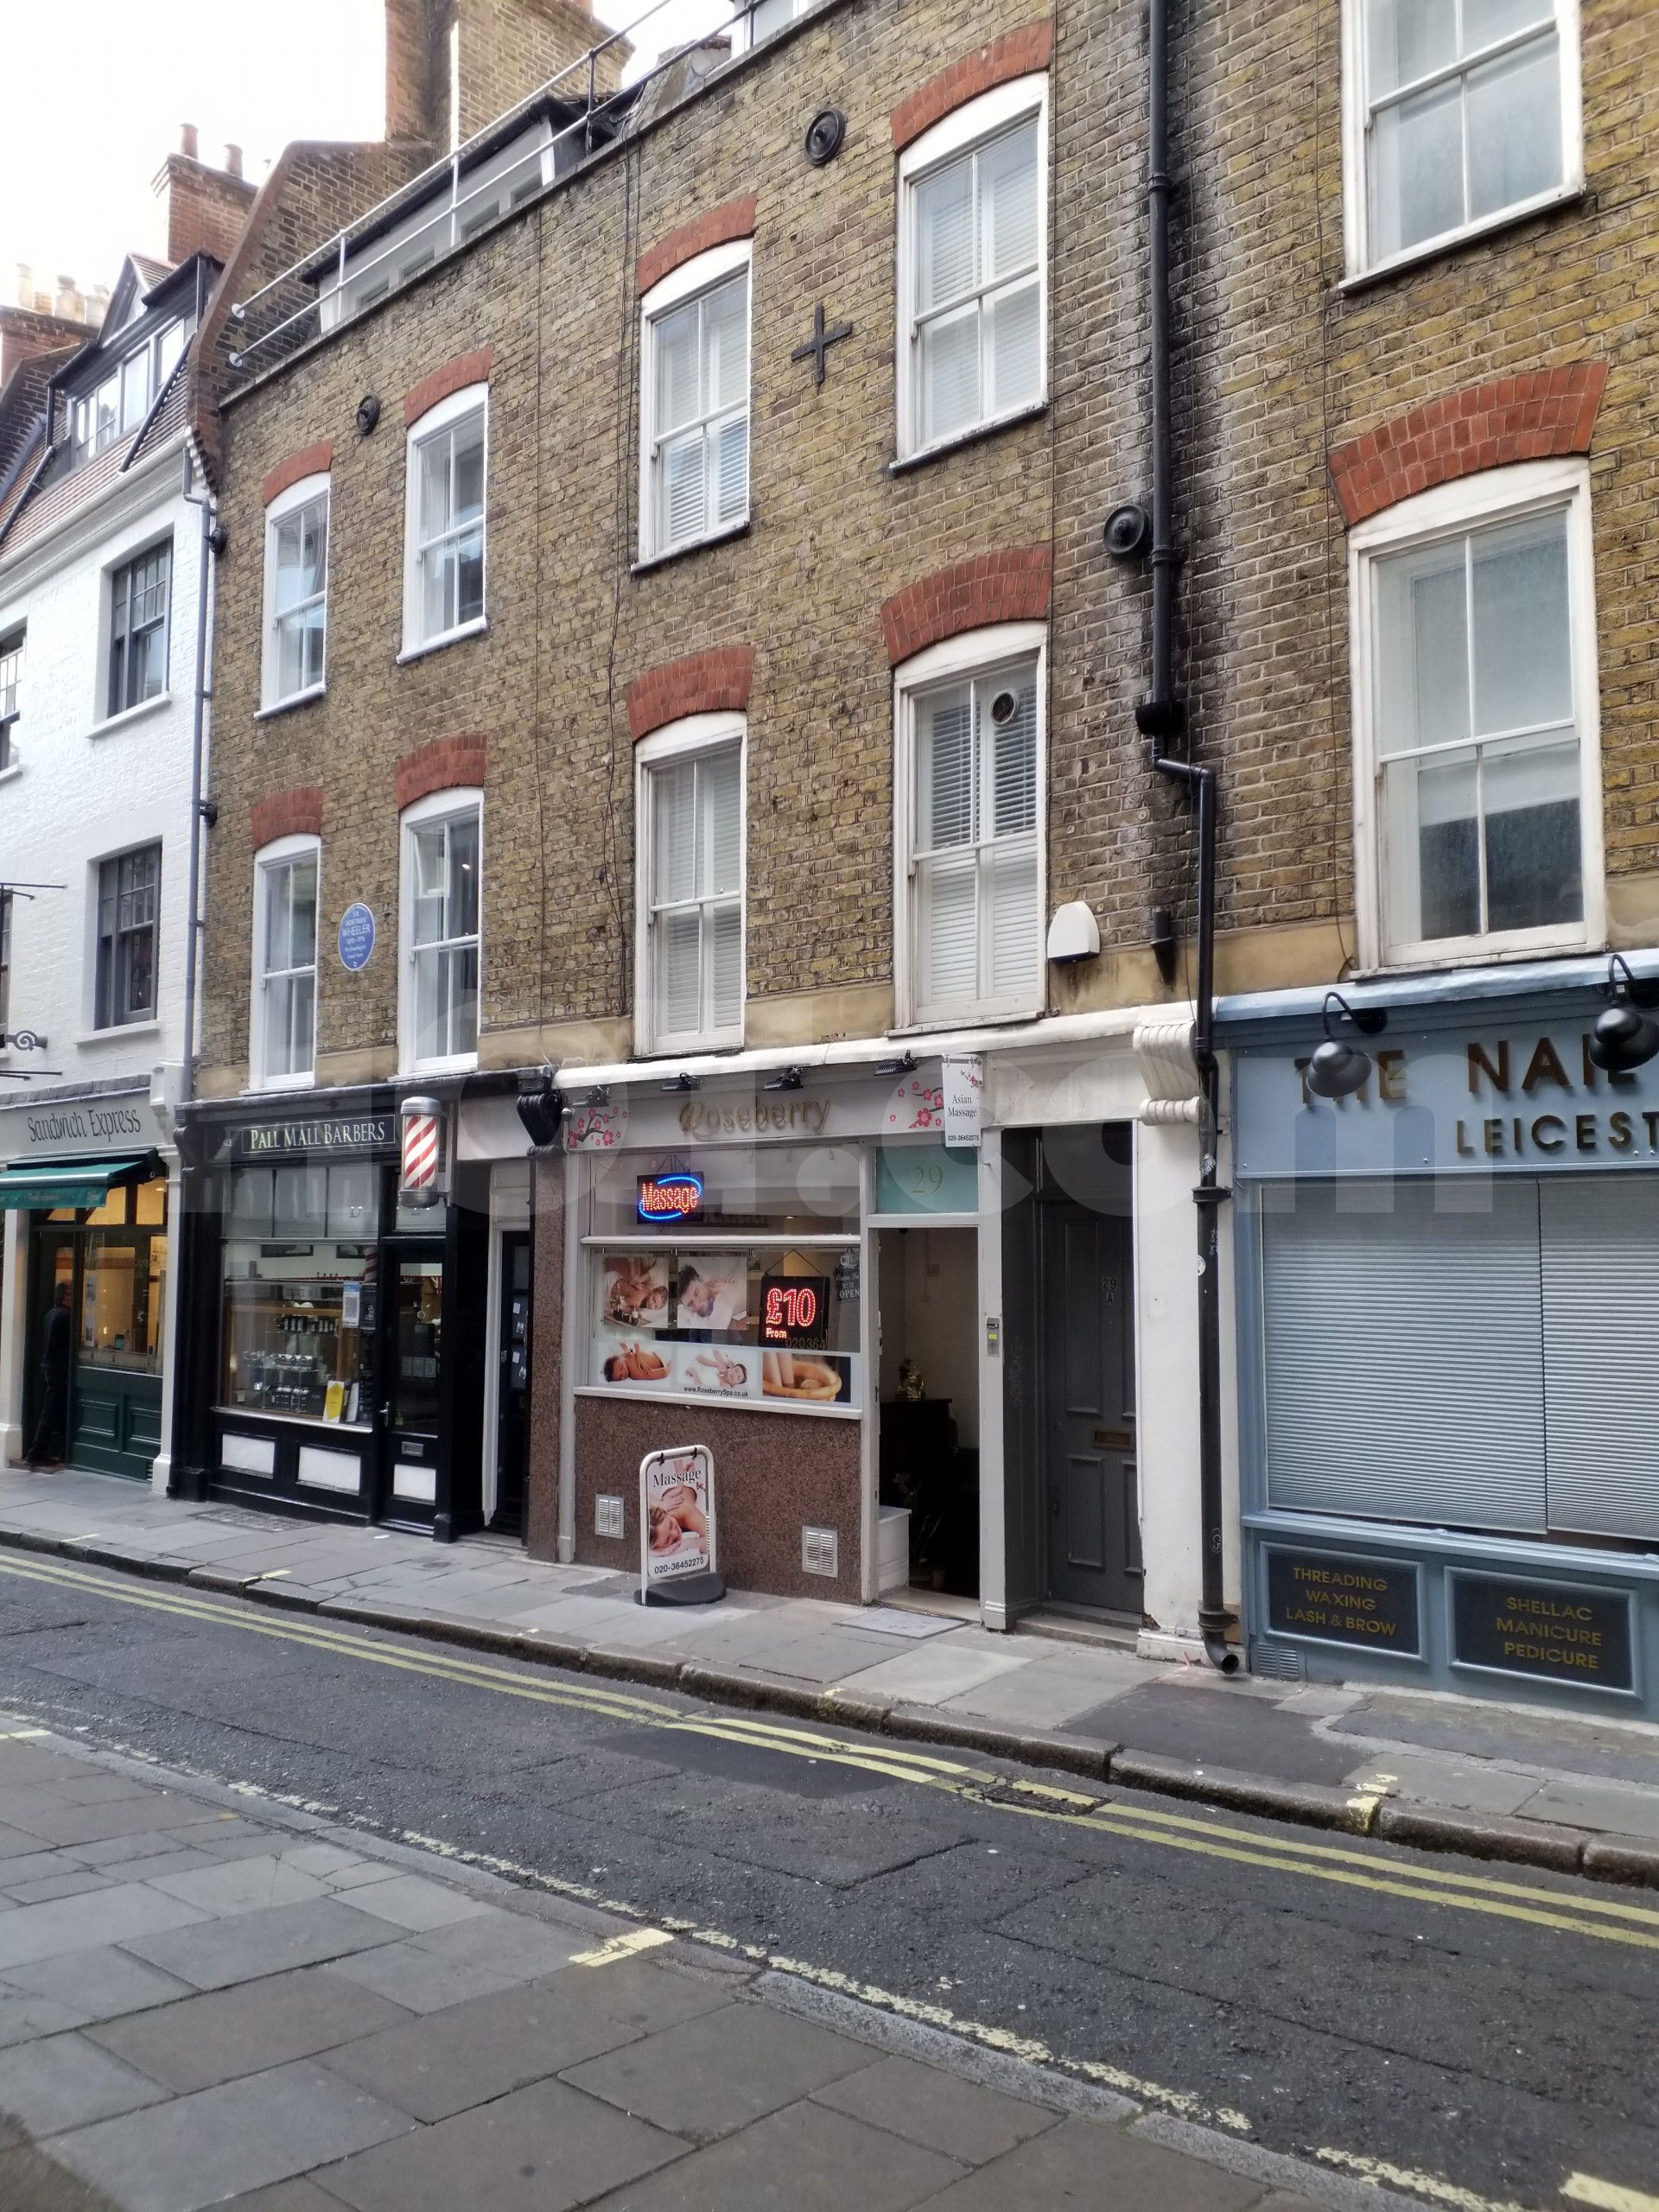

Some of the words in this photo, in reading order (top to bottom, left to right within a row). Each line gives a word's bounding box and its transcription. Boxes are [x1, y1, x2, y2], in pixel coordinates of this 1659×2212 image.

[342, 924, 372, 937] WHEELER
[1467, 1033, 1637, 1094] NAI
[952, 1094, 972, 1104] Asian
[28, 1112, 86, 1141] Sandwich
[87, 1109, 141, 1141] Express
[678, 1098, 830, 1141] Roseberry
[948, 1107, 977, 1118] Massage
[251, 1128, 280, 1149] PALL
[284, 1127, 321, 1146] MALL
[324, 1122, 385, 1144] BARBERS
[912, 1166, 944, 1194] 29
[641, 1182, 699, 1214] Massage
[1103, 1278, 1116, 1290] 29
[766, 1287, 816, 1327] £10
[766, 1327, 787, 1338] From
[683, 1385, 749, 1397] www.RoseberrySpa.co.uk
[652, 1469, 702, 1488] Massage
[654, 1556, 704, 1574] 020-36452275
[1293, 1567, 1389, 1592] THREADING
[1306, 1589, 1376, 1611] WAXING
[1507, 1597, 1592, 1622] SHELLAC
[1286, 1607, 1326, 1625] LASH
[1331, 1616, 1343, 1627] &
[1345, 1618, 1396, 1637] BROW
[1495, 1617, 1603, 1647] MANICURE
[1503, 1642, 1599, 1669] PEDICURE
